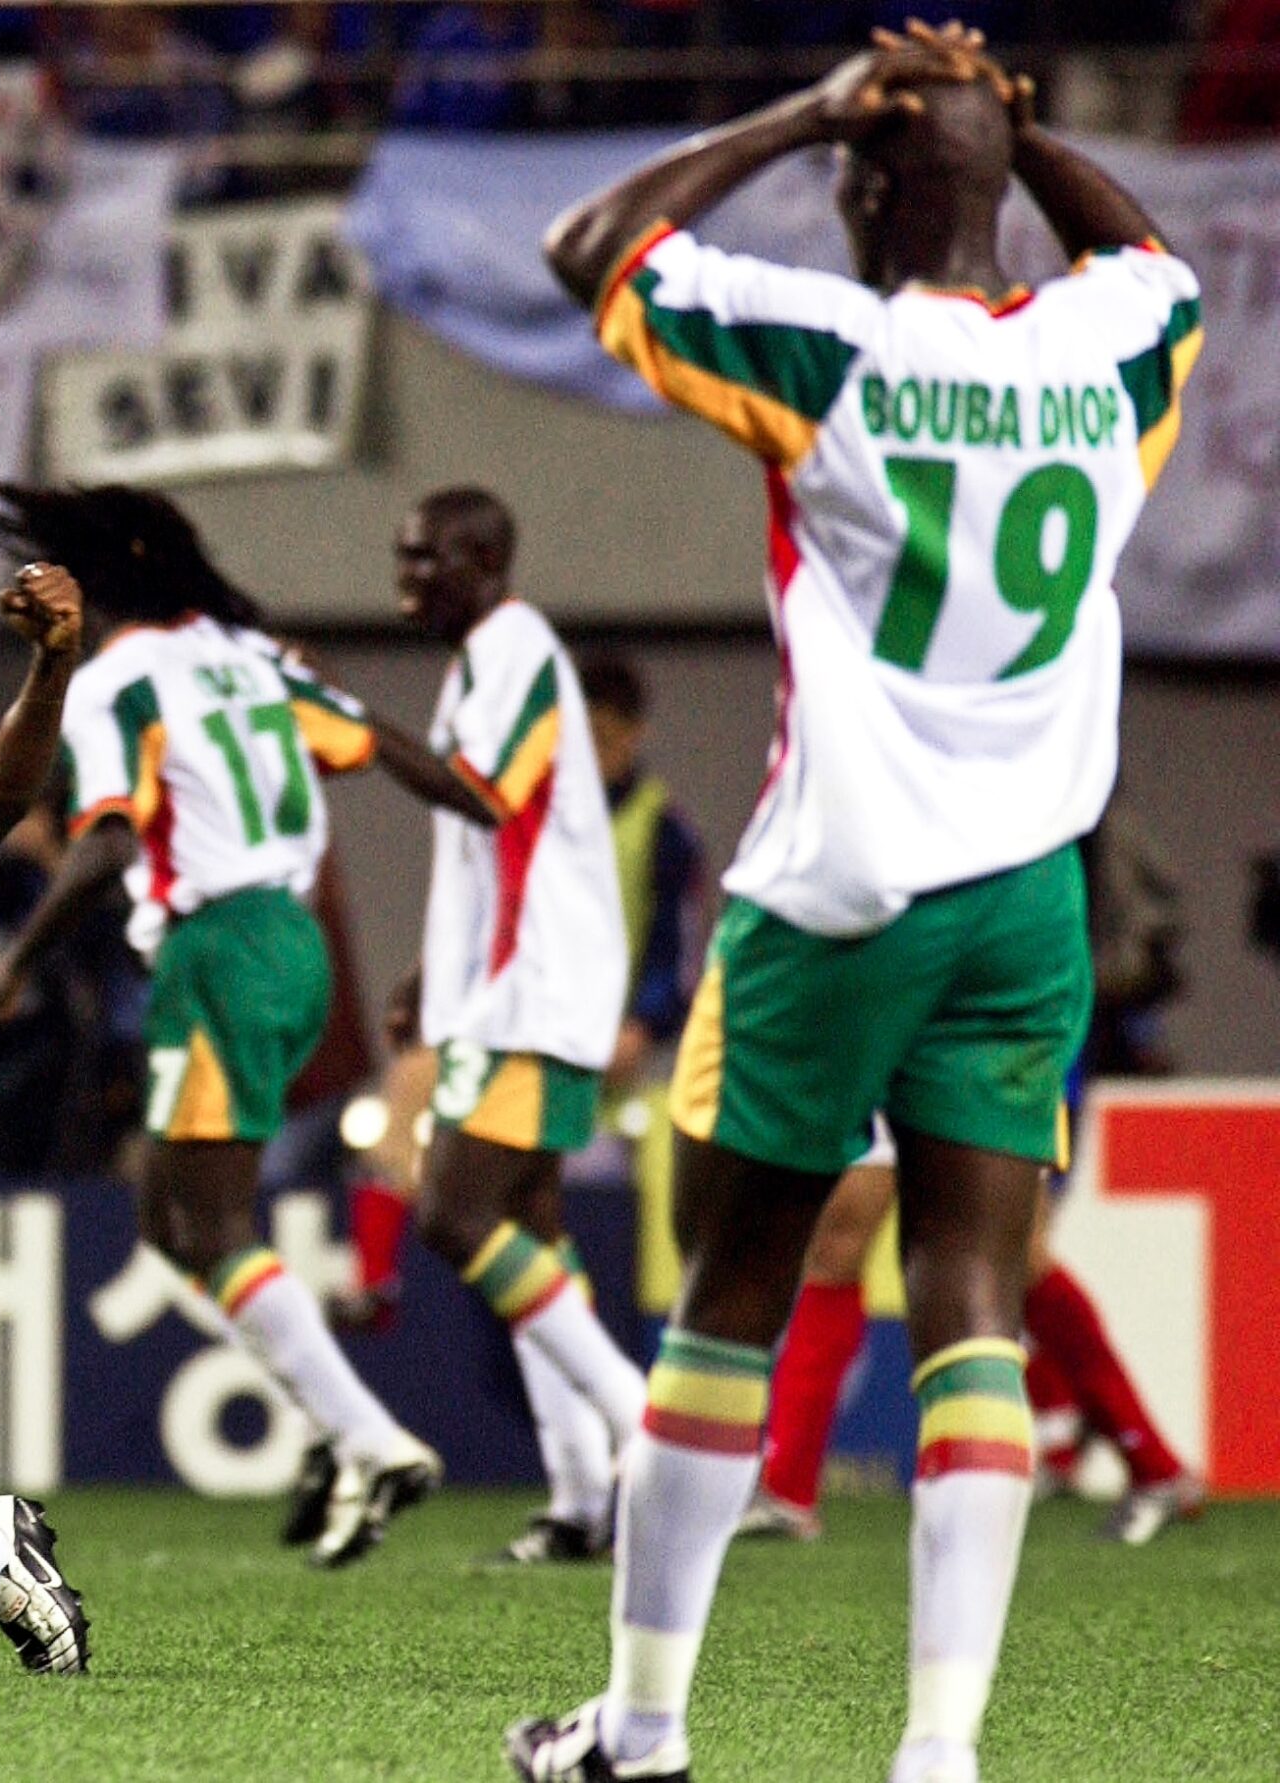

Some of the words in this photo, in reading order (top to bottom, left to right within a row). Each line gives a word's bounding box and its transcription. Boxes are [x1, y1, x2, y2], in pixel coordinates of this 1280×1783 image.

[860, 375, 1021, 449] BOUBA
[1039, 382, 1121, 449] DIOP
[871, 454, 1098, 681] 19
[200, 701, 312, 847] 17
